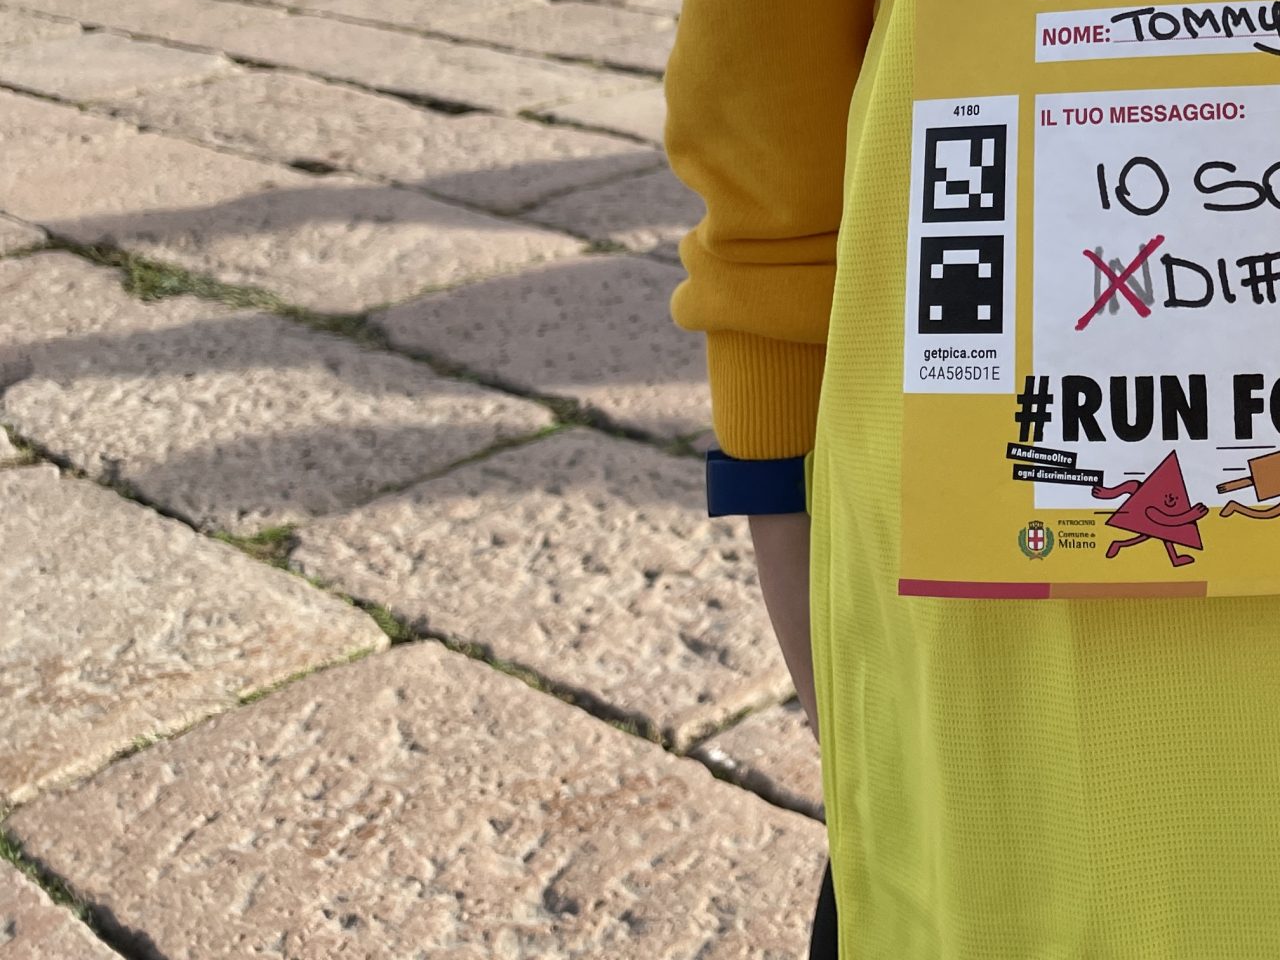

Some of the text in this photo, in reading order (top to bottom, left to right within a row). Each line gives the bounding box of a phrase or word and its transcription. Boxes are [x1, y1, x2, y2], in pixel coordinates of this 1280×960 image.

[1041, 25, 1111, 47] NOME:
[953, 104, 980, 117] 4180
[1040, 102, 1246, 126] IL TUO MESSAGGIO:
[1097, 156, 1169, 216] IO
[924, 347, 997, 362] getpica.com
[919, 366, 1000, 381] C4A505D1E
[1015, 374, 1208, 442] #RUN
[1011, 447, 1073, 464] #AndiamoOltre
[1017, 469, 1099, 482] ogni discriminazione
[1057, 530, 1089, 538] Comune
[1058, 539, 1096, 549] Milano
